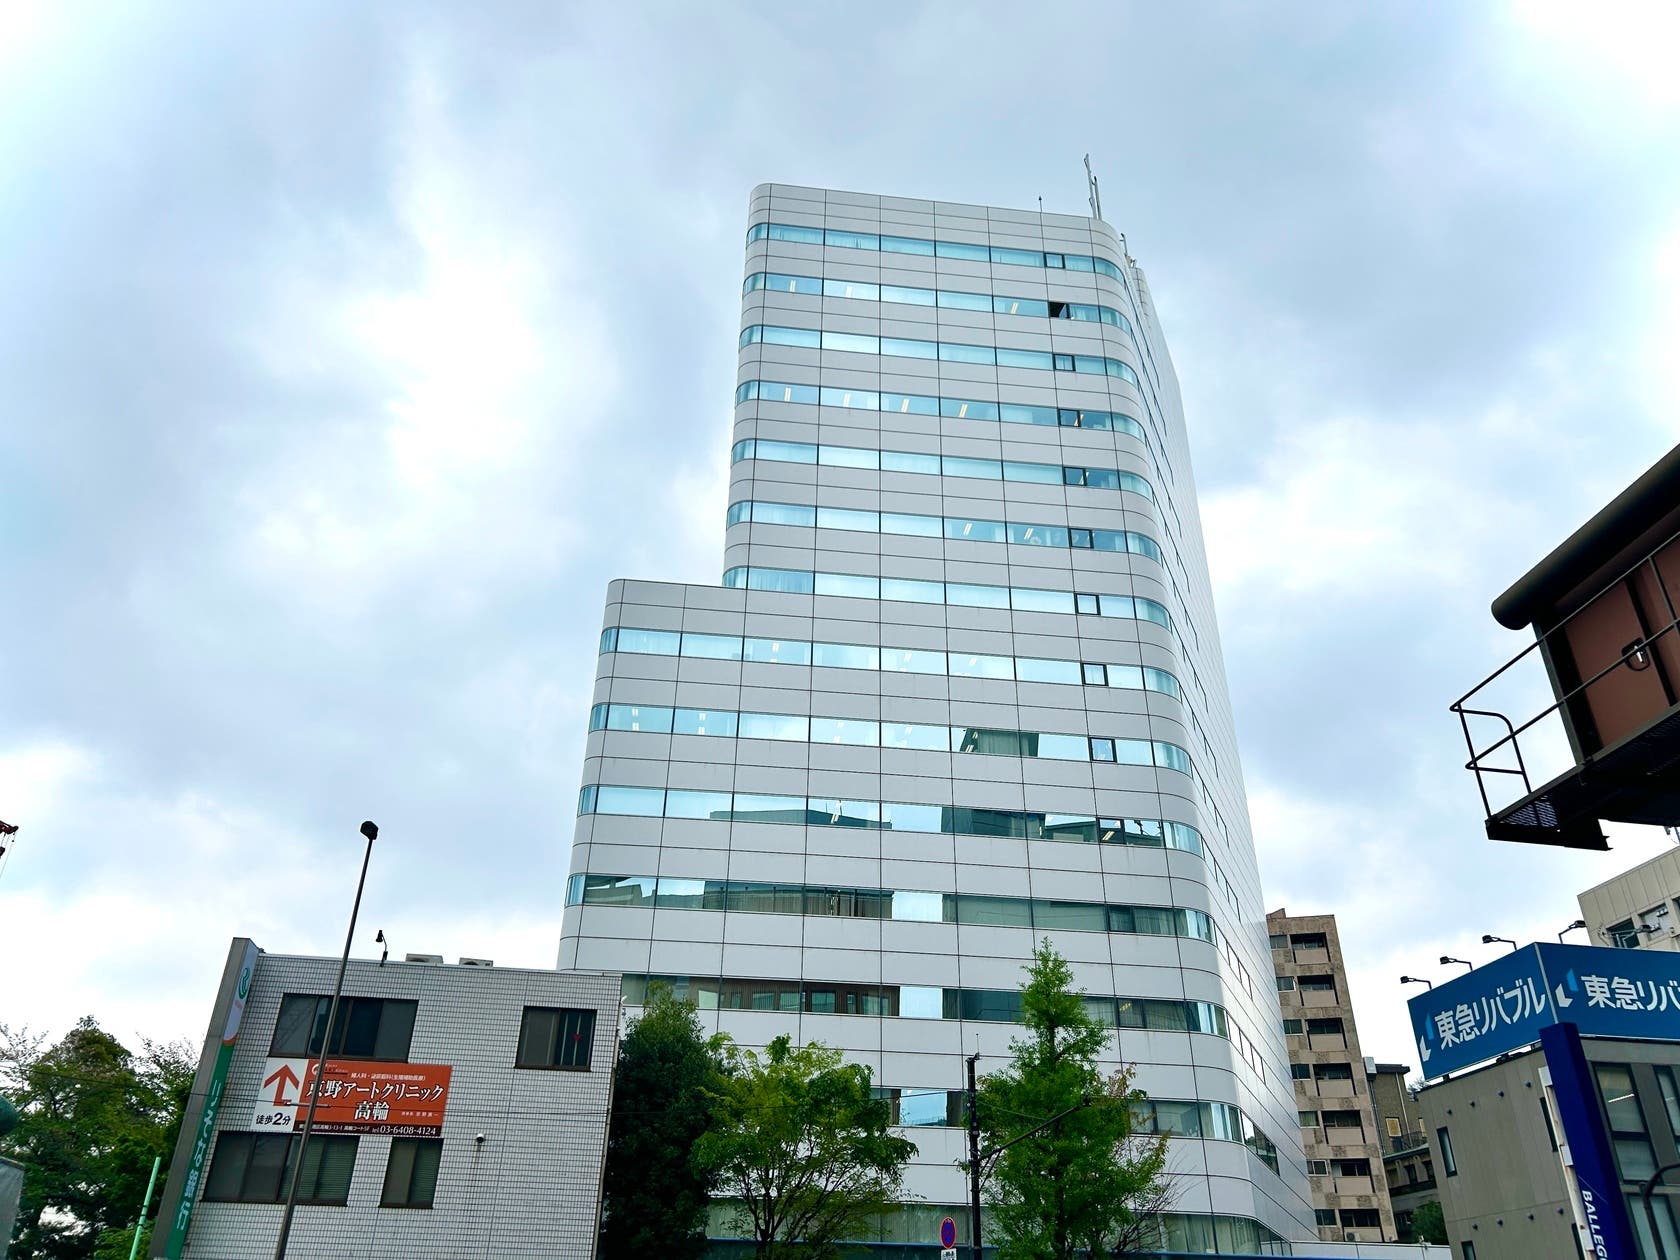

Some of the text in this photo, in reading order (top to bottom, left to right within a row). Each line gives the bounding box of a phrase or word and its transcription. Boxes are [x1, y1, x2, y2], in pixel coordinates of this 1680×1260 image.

[1581, 975, 1680, 1012] 東急リバ
[1435, 976, 1546, 1051] 東急リバブル
[255, 1112, 291, 1126] 徒歩2分
[354, 1101, 390, 1121] 高輪
[380, 1125, 436, 1135] 03-6408-4124
[177, 1080, 221, 1231] りそな銀行
[1582, 1190, 1609, 1260] BALLEG
